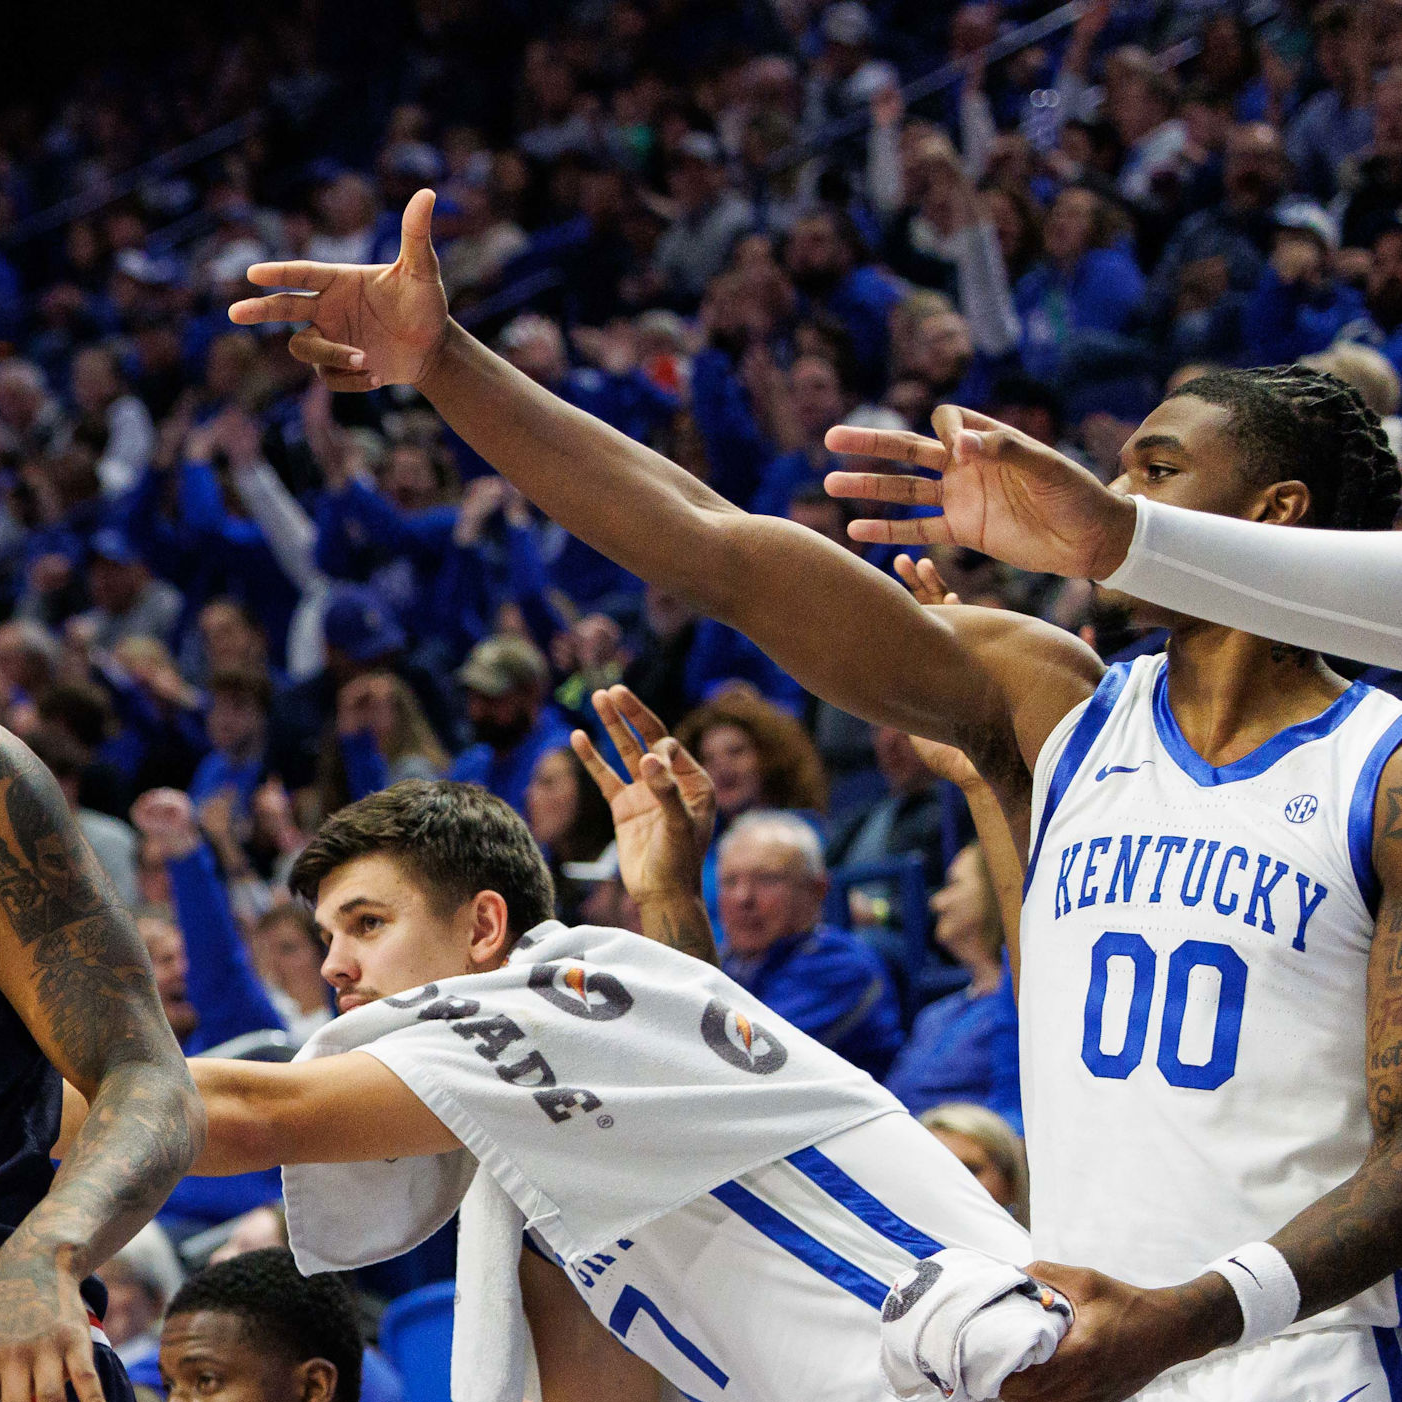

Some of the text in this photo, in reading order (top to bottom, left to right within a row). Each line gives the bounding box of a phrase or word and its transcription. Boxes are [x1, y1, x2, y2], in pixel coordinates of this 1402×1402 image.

[1285, 795, 1318, 823] SEC
[1055, 835, 1327, 952] KENTUCKY
[1081, 932, 1248, 1091] 00
[609, 1284, 730, 1390] 7
